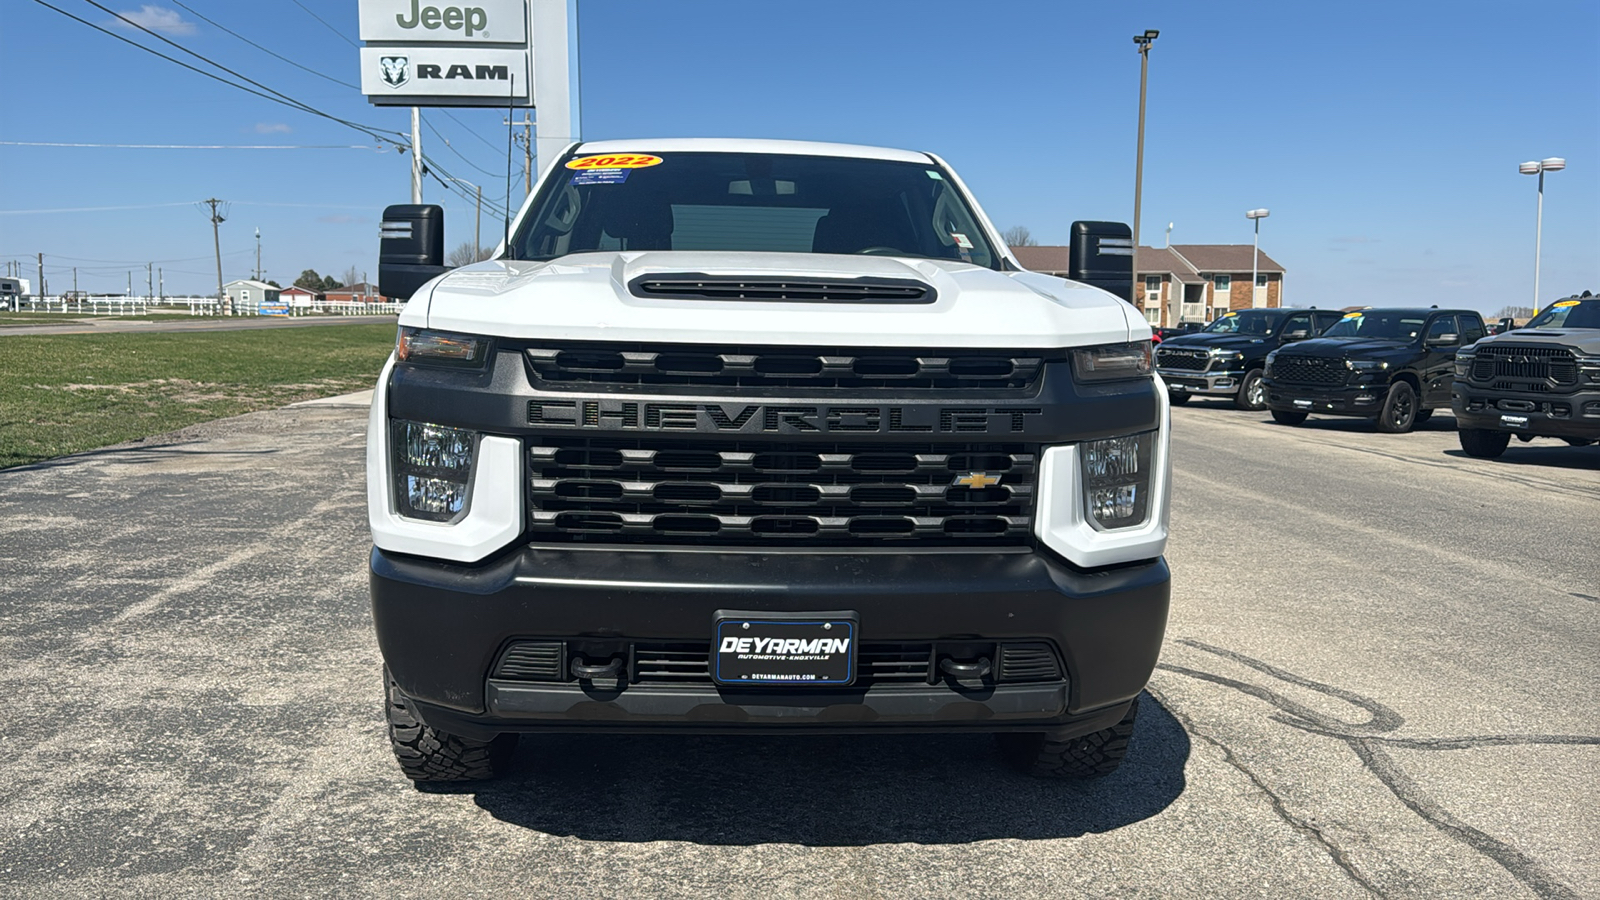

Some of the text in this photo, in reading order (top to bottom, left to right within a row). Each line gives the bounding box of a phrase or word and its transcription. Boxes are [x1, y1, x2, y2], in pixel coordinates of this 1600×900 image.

[396, 0, 487, 37] Jeep
[417, 64, 508, 80] RAM
[575, 156, 654, 168] 2022
[527, 400, 1043, 433] CHEVROLET
[719, 637, 850, 654] DEYARMAN
